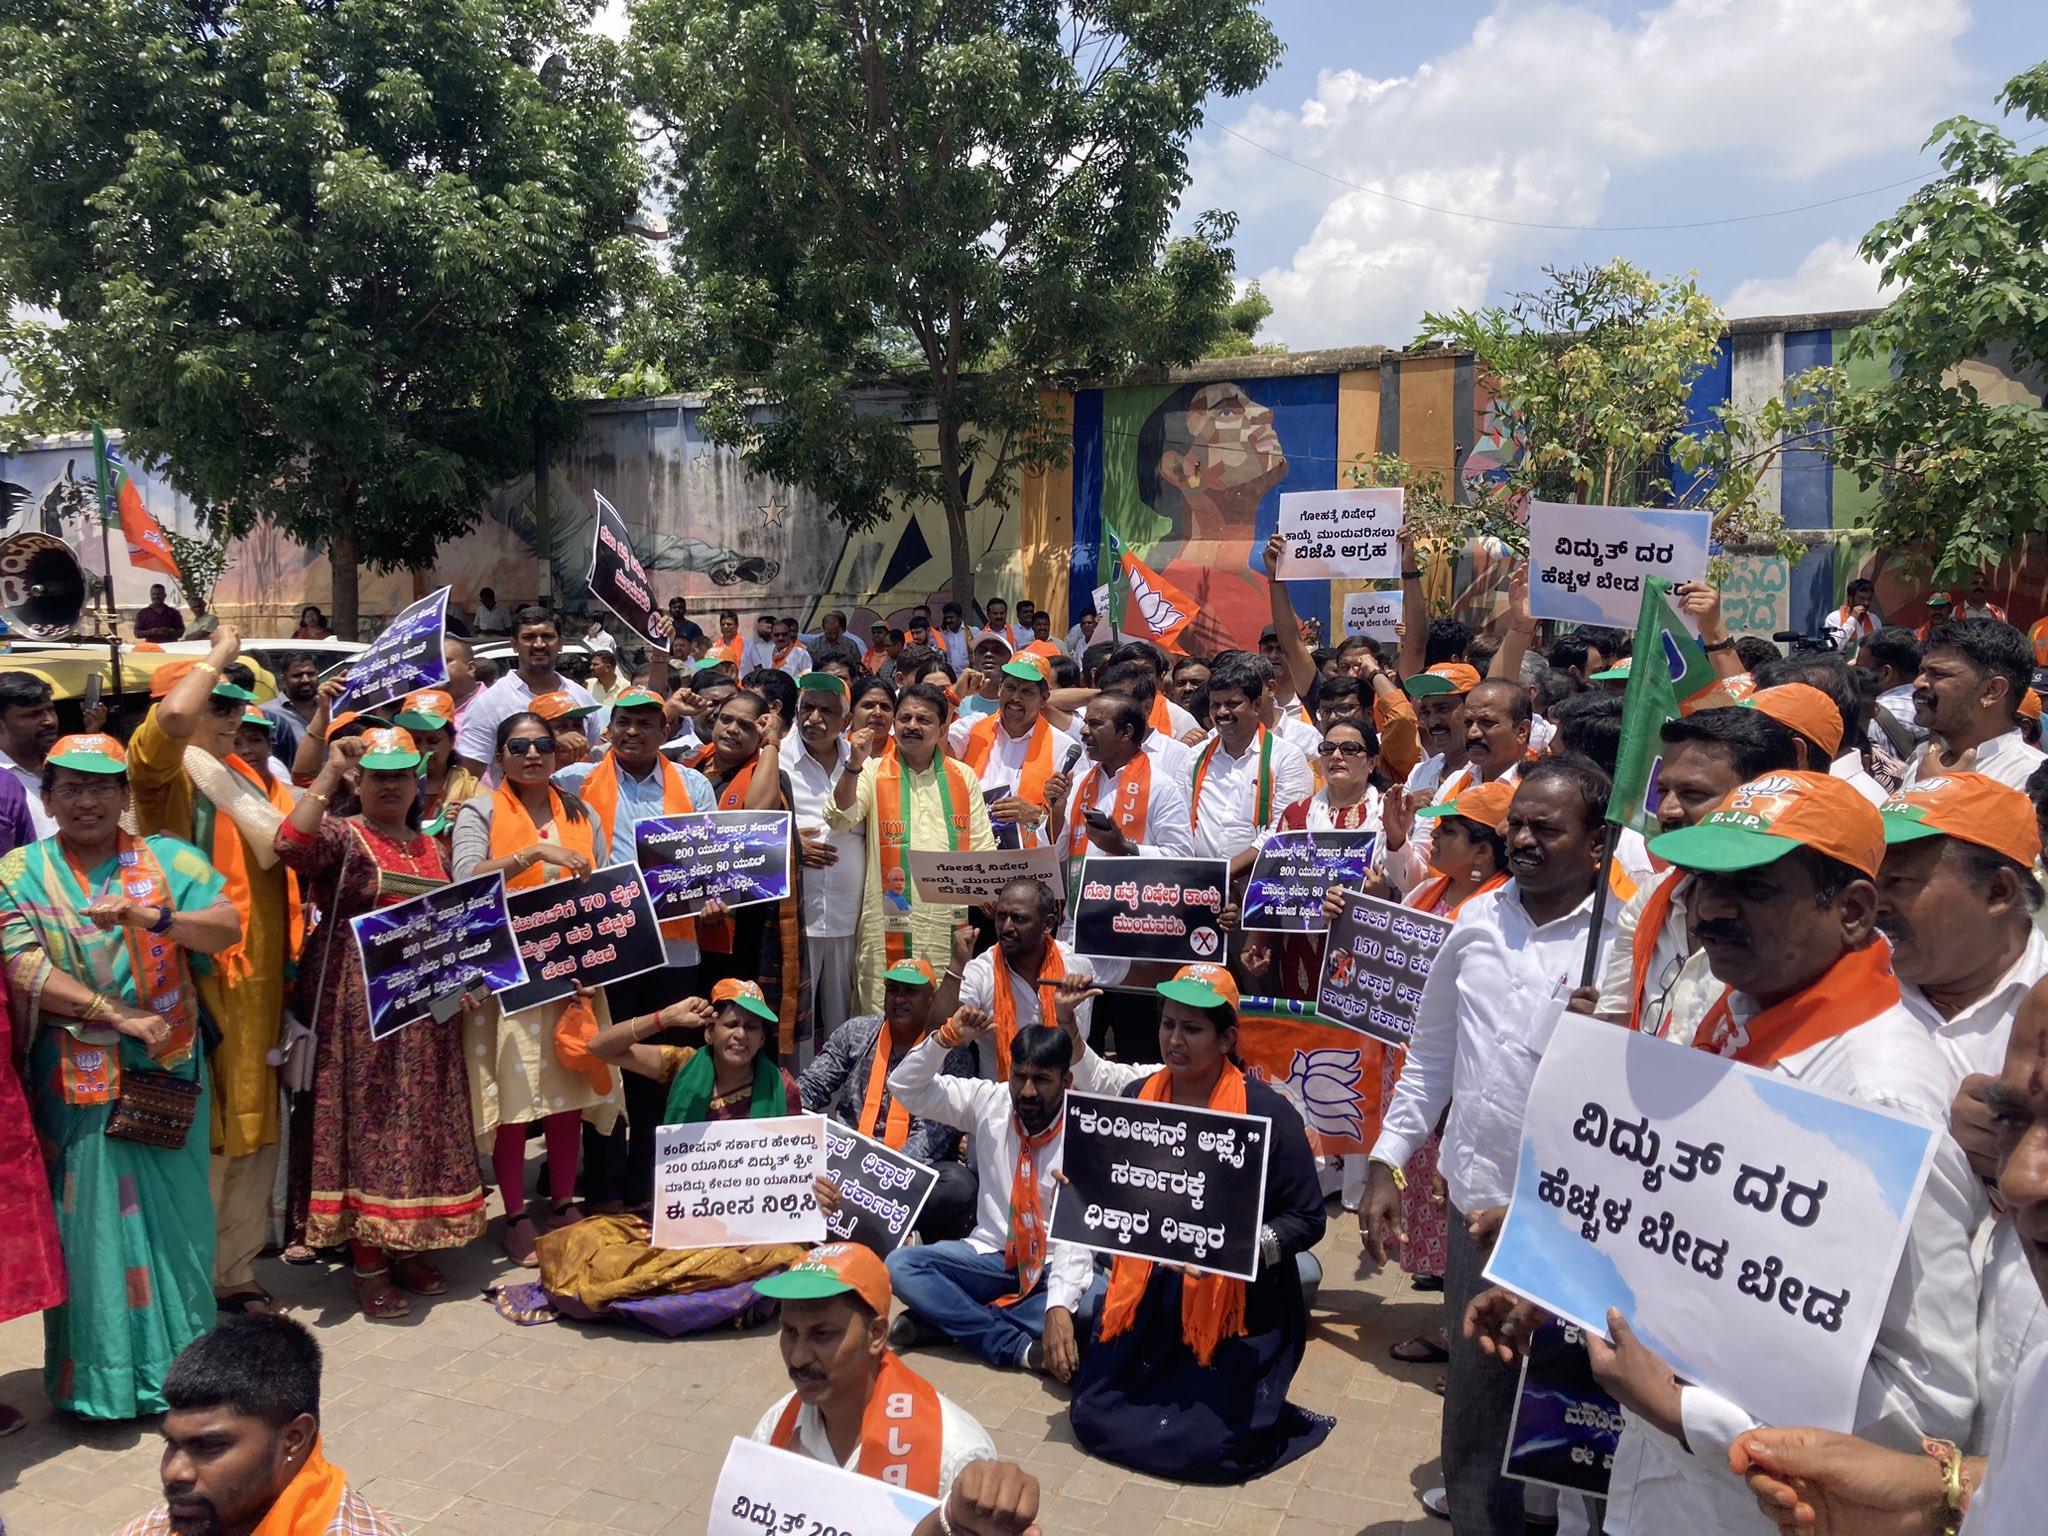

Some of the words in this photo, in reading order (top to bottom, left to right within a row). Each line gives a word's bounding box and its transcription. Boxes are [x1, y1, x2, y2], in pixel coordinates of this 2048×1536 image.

[1300, 509, 1339, 524] ಗೋಹತ್ಯೆ
[1341, 508, 1376, 520] ನಿಷೇಧ
[1285, 529, 1313, 543] ಕಾಯ್ದೆ
[1317, 527, 1395, 539] ಮುಂದುವರಿಸಲು
[1295, 542, 1336, 559] ಬಿಜೆಪಿ
[1341, 542, 1387, 561] ಆಗ್ರಹ
[1555, 537, 1628, 567] ವಿದ್ಯುತ್
[1635, 542, 1674, 564] ದರ
[1541, 567, 1591, 593] ಹೆಚ್ಚಳ
[1597, 572, 1639, 592] ಬೇಡ
[1377, 605, 1390, 614] ದರ
[390, 653, 400, 665] 80
[1121, 781, 1139, 826] BJP
[1710, 811, 1760, 830] B.J.P.
[675, 847, 694, 860] 200
[716, 861, 730, 872] 80
[988, 861, 1029, 871] ನಿಷೇಧ
[1279, 866, 1296, 877] 200
[938, 885, 988, 896] ಬಿಜೆಪಿ
[1084, 881, 1111, 900] ಗೋ
[1114, 881, 1139, 910] ಹತ್ಯೆ
[1142, 883, 1180, 906] ನಿಷೇಧ
[1183, 886, 1221, 913] ಕಾಯ್ದೆ
[1312, 886, 1323, 897] 80
[580, 892, 607, 913] 70
[566, 923, 593, 945] ದರ
[597, 910, 636, 938] ಹೆಚ್ಚಳ
[1353, 907, 1389, 928] ಹಾಲಿನ
[402, 943, 420, 959] 200
[442, 952, 456, 966] 80
[541, 956, 577, 980] ಬೇಡ
[581, 943, 617, 968] ಬೇಡ
[1385, 946, 1406, 966] ರೂ
[1358, 971, 1392, 997] ಧಿಕ್ಕಾರ
[1070, 1106, 1187, 1158] “ಕಂಡೀಷನ್ಸ್
[664, 1140, 721, 1156] ಕಂಡೀಷನ್
[725, 1137, 768, 1151] ಸರ್ಕಾರ
[771, 1134, 818, 1149] ಹೇಳಿದ್ದು
[665, 1163, 687, 1174] 200
[691, 1157, 744, 1171] ಯೂನಿಟ್
[747, 1154, 790, 1171] ವಿದ್ಯುತ್
[793, 1154, 813, 1169] ಫ್ರೀ
[861, 1152, 916, 1190] ಧಿಕ್ಕಾರ!
[1573, 1101, 1725, 1194] ವಿದ್ಯುತ್
[1732, 1163, 1829, 1228] ದರ
[665, 1179, 707, 1194] ಮಾಡಿದ್ದು
[709, 1175, 742, 1189] ಕೇವಲ
[745, 1177, 760, 1187] 80
[763, 1172, 814, 1186] ಯೂನಿಟ್
[1111, 1159, 1206, 1210] ಸರ್ಕಾರಕ್ಕೆ
[665, 1200, 686, 1220] ಈ
[692, 1195, 754, 1217] ಮೋಸ
[762, 1193, 817, 1219] ನಿಲ್ಲಿಸಿ
[840, 1178, 910, 1234] ಸರ್ಕಾರಕ್ಕೆ
[1084, 1203, 1150, 1244] ಧಿಕ್ಕಾರ
[1160, 1217, 1226, 1258] ಧಿಕ್ಕಾರ
[1538, 1167, 1632, 1243] ಹೆಚ್ಚಳ
[1637, 1210, 1730, 1281] ಬೇಡ
[1736, 1255, 1852, 1333] ಬೇಡ
[731, 1495, 806, 1536] ವಿದ್ಯುತ್
